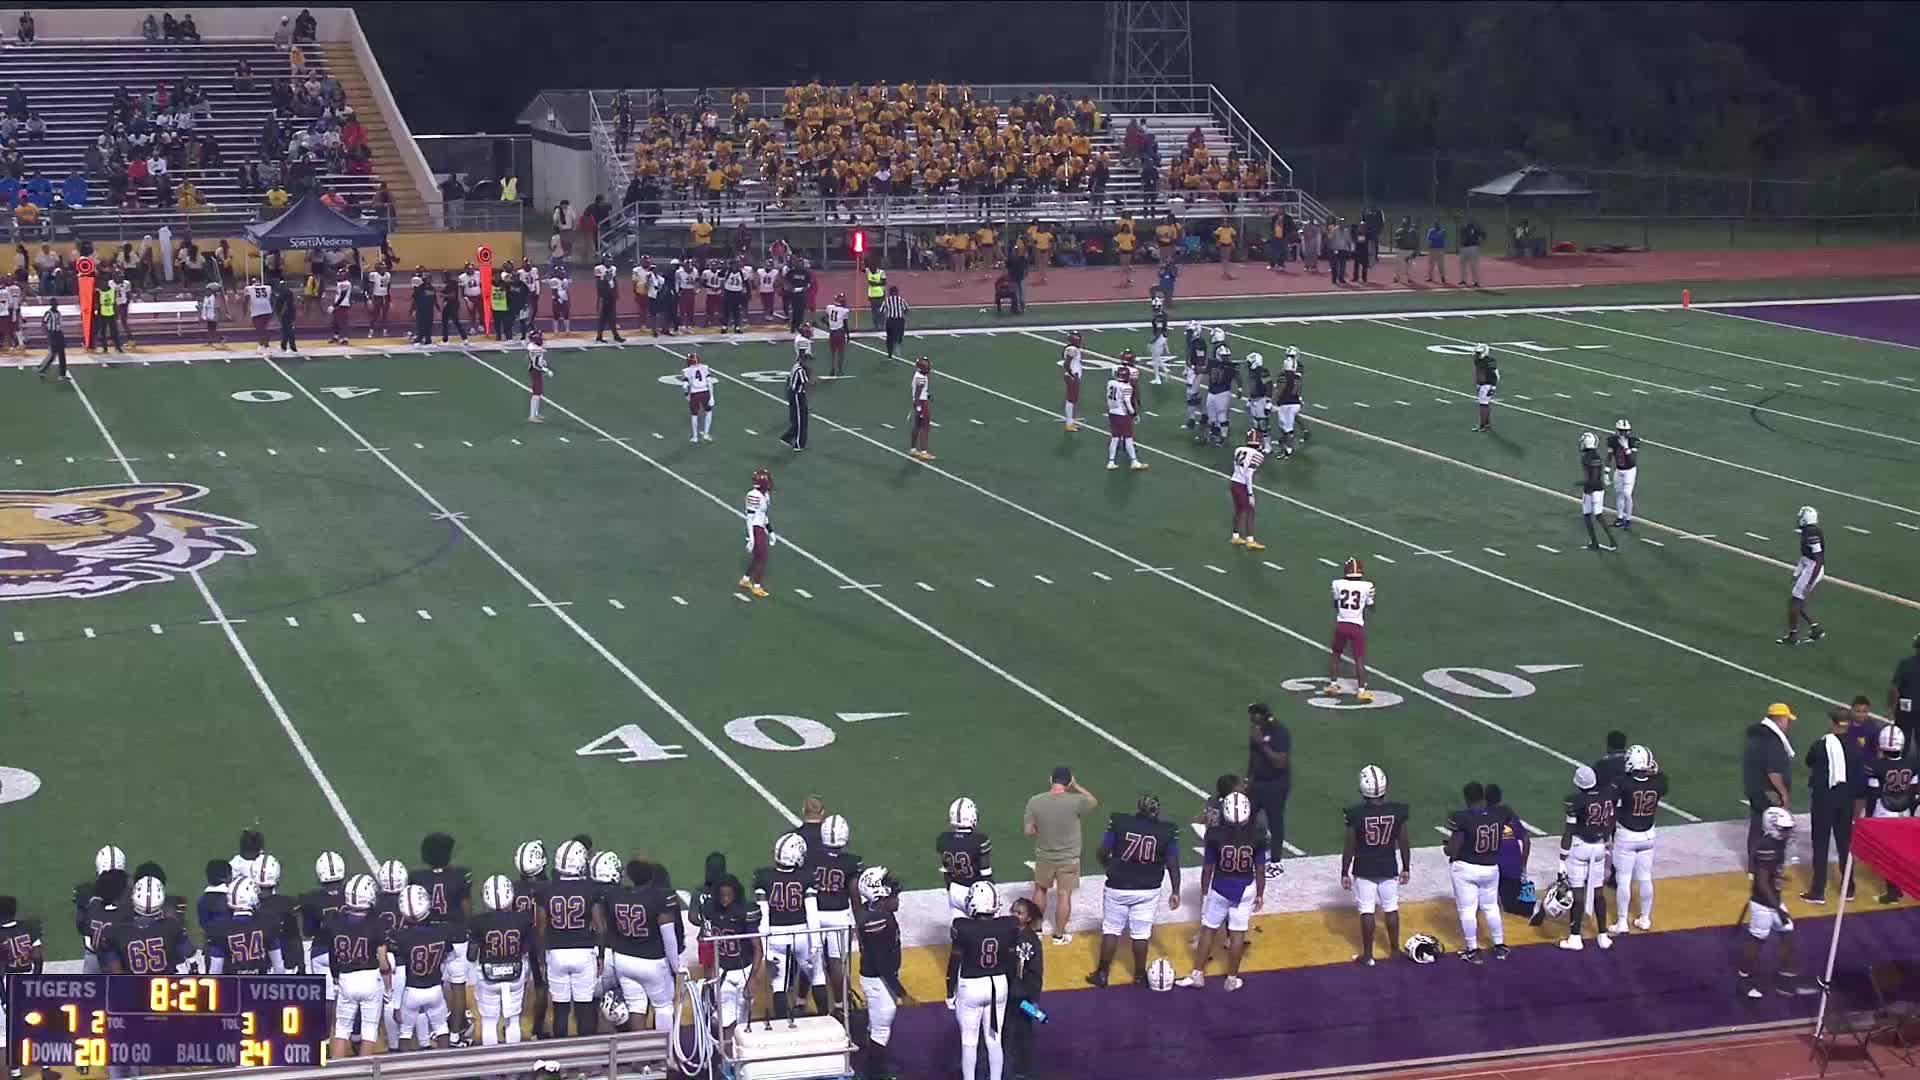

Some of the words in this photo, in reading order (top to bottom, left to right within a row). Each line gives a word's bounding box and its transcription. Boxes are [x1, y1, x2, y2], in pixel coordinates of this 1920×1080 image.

[694, 369, 702, 382] 4
[1339, 589, 1361, 611] 23
[1632, 790, 1658, 817] 12
[1364, 814, 1395, 846] 57
[1475, 825, 1499, 854] 61
[1120, 831, 1158, 864] 70
[1221, 845, 1254, 873] 86
[431, 883, 449, 915] 4
[549, 895, 586, 930] 92
[768, 880, 804, 913] 46
[614, 903, 649, 938] 52
[127, 936, 168, 975] 65
[227, 929, 267, 965] 54
[334, 934, 369, 966] 84
[410, 940, 446, 977] 87
[485, 928, 521, 960] 36
[980, 937, 999, 969] 8
